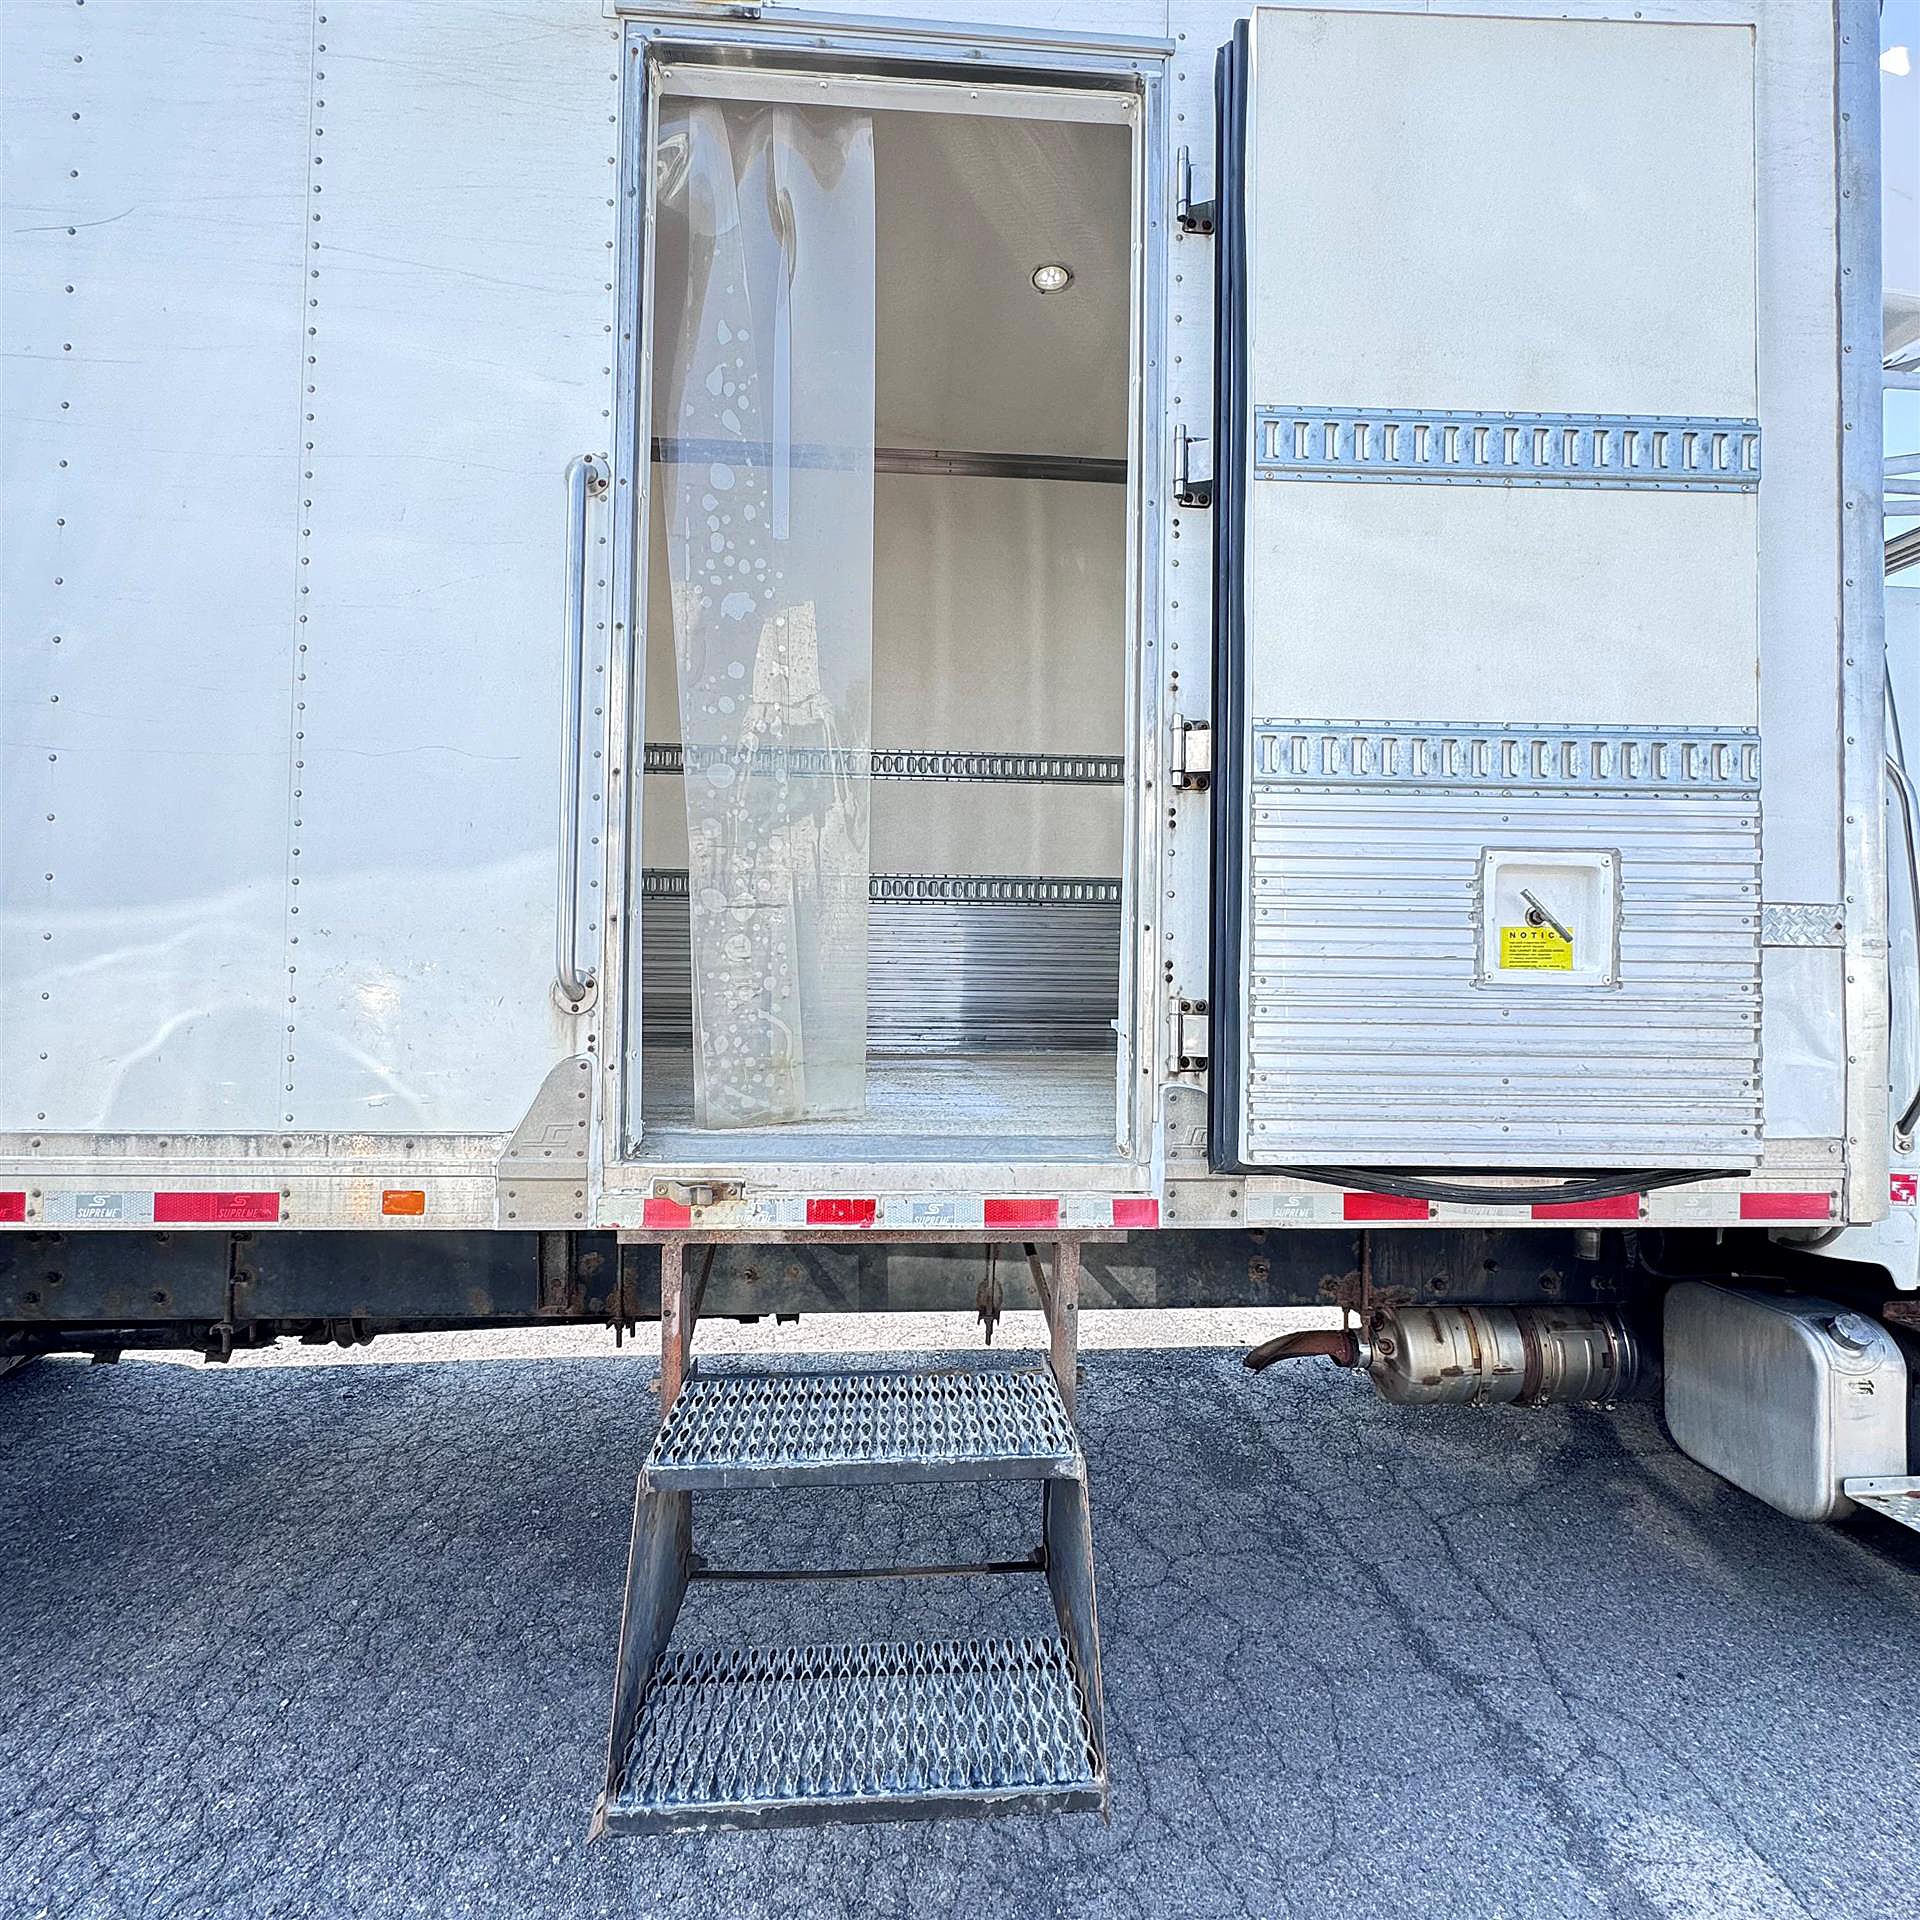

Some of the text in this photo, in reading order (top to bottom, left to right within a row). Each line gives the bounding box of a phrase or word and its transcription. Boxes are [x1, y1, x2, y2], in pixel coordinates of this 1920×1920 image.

[78, 1208, 118, 1218] SUPREME
[219, 1208, 258, 1218] SUPREME
[1275, 1208, 1311, 1218] SUPREME
[914, 1215, 951, 1225] SUPREME
